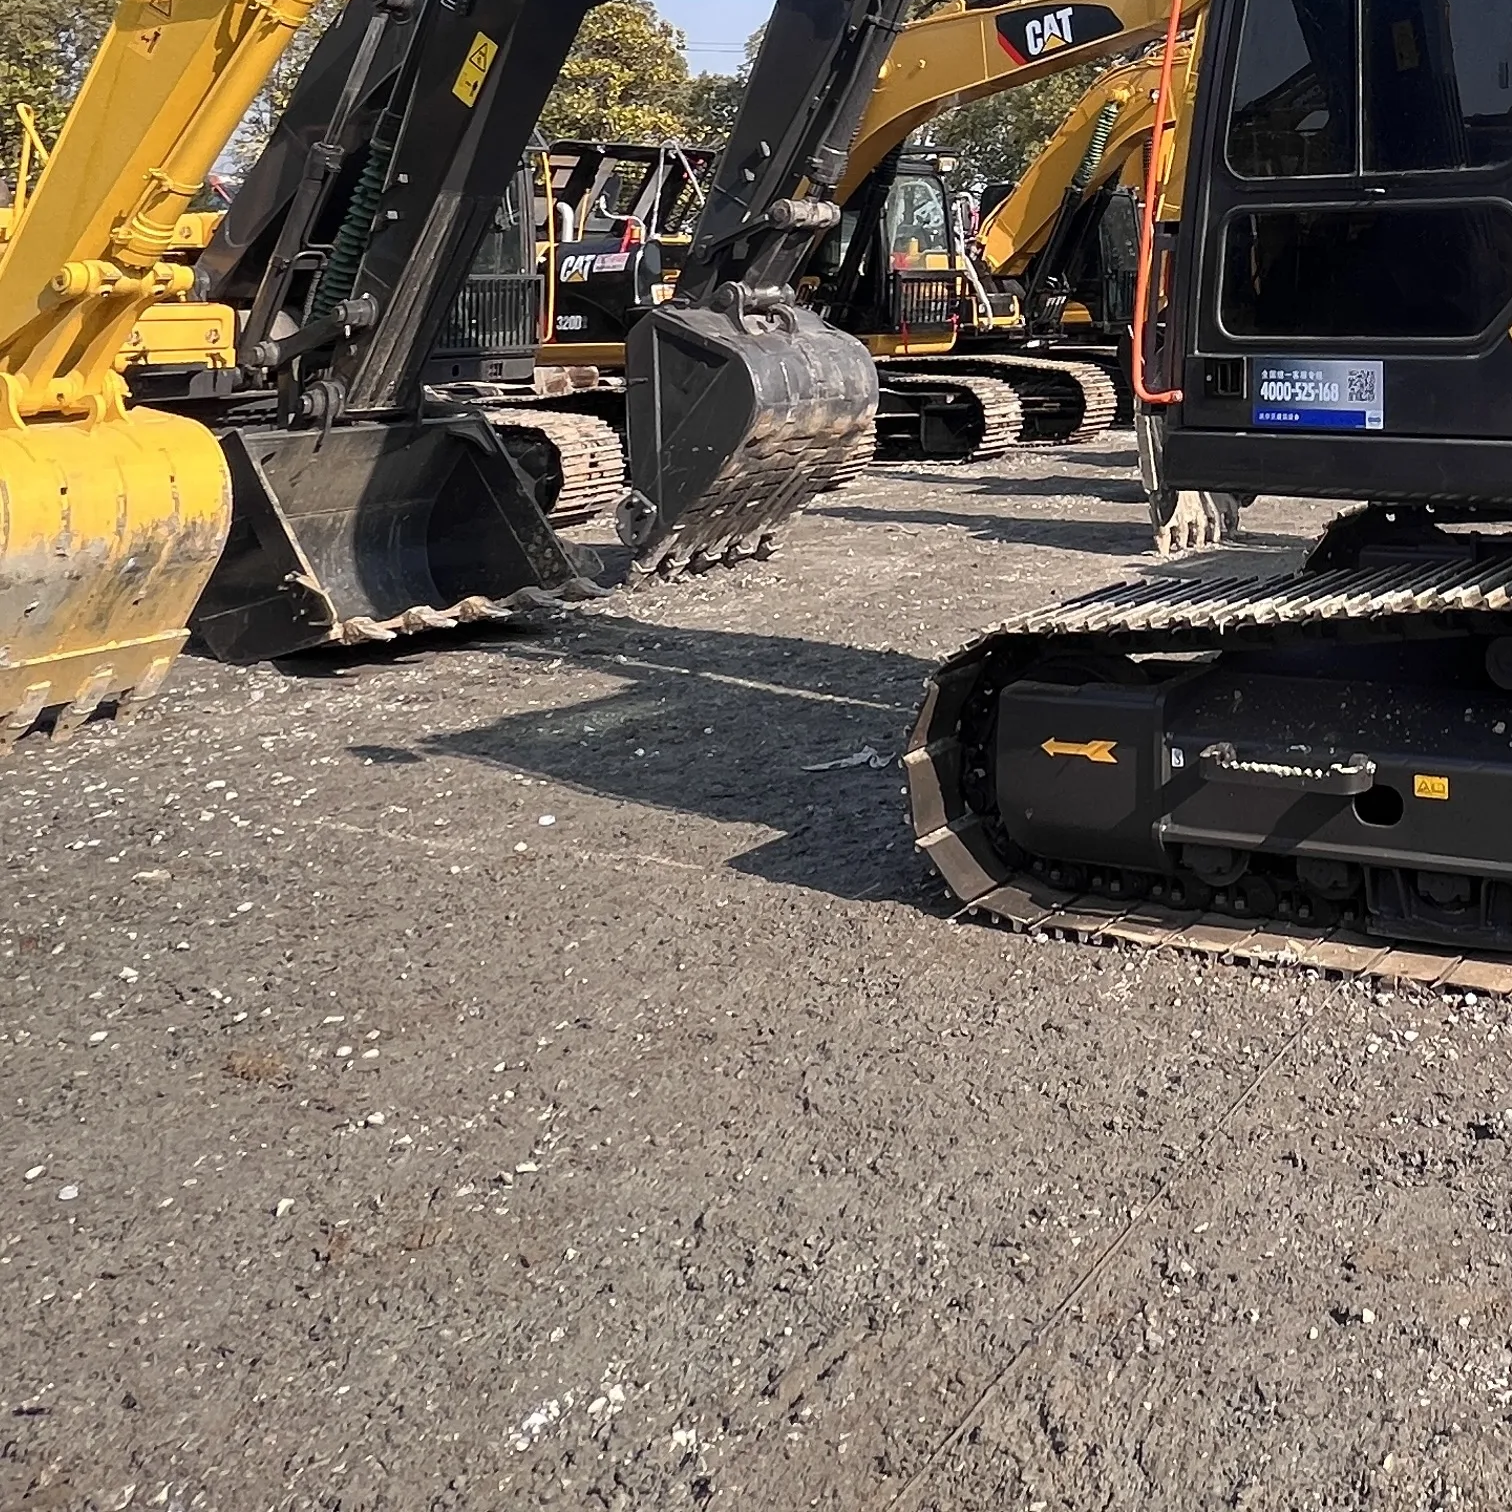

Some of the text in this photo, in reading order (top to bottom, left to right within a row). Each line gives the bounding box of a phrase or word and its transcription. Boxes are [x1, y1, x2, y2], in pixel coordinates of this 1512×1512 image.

[1025, 6, 1073, 55] CAT
[560, 254, 597, 282] CAT
[1260, 381, 1340, 402] 4000-525-168
